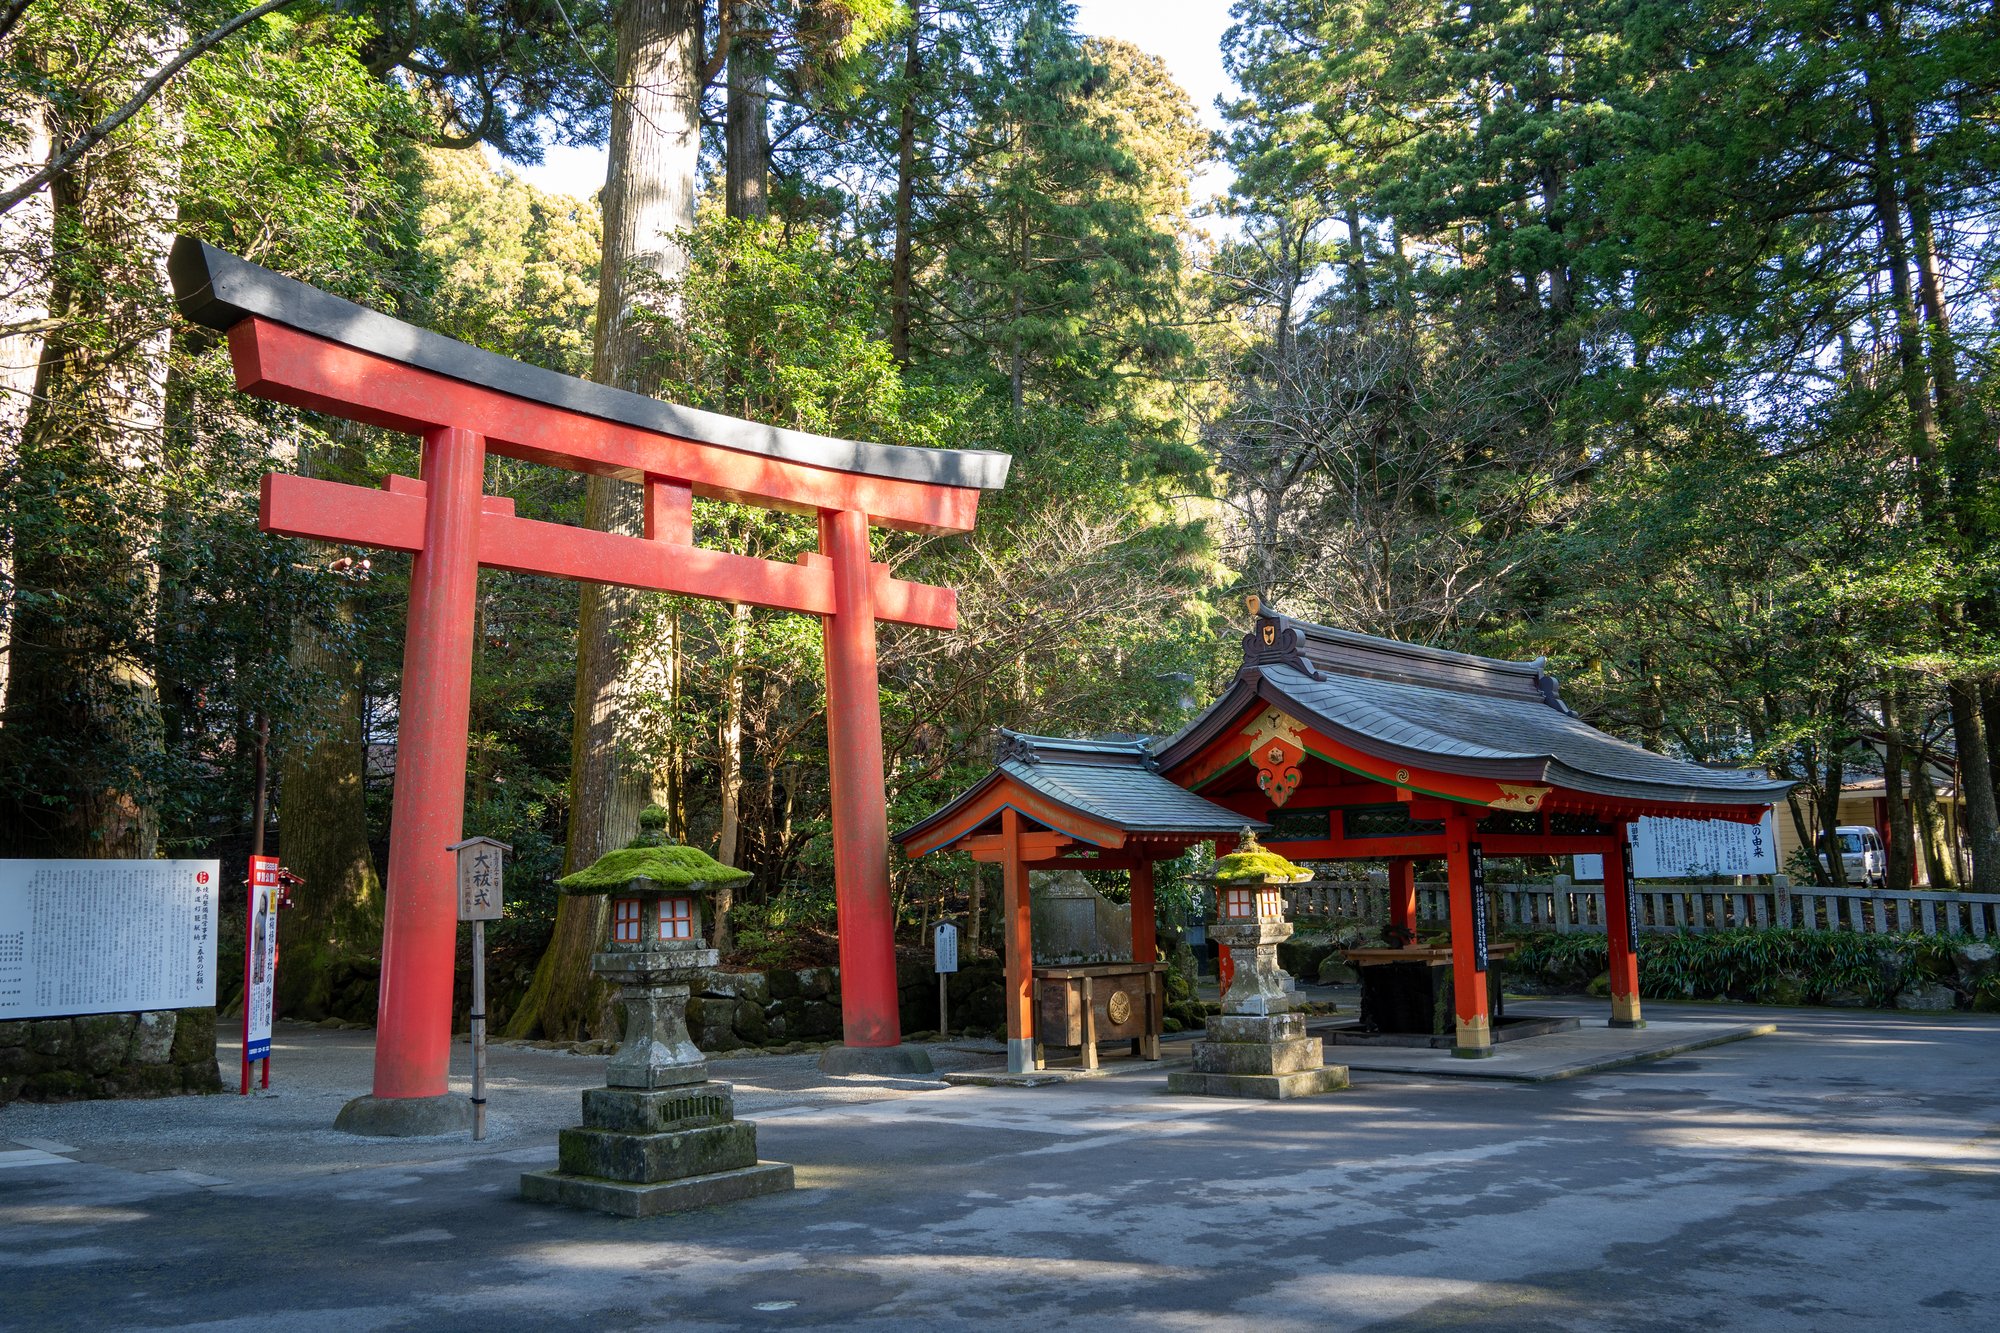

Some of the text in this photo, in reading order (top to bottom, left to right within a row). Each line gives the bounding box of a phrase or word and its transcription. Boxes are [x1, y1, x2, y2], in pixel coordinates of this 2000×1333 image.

[1751, 823, 1765, 859] の由来
[473, 850, 491, 908] 大祓式
